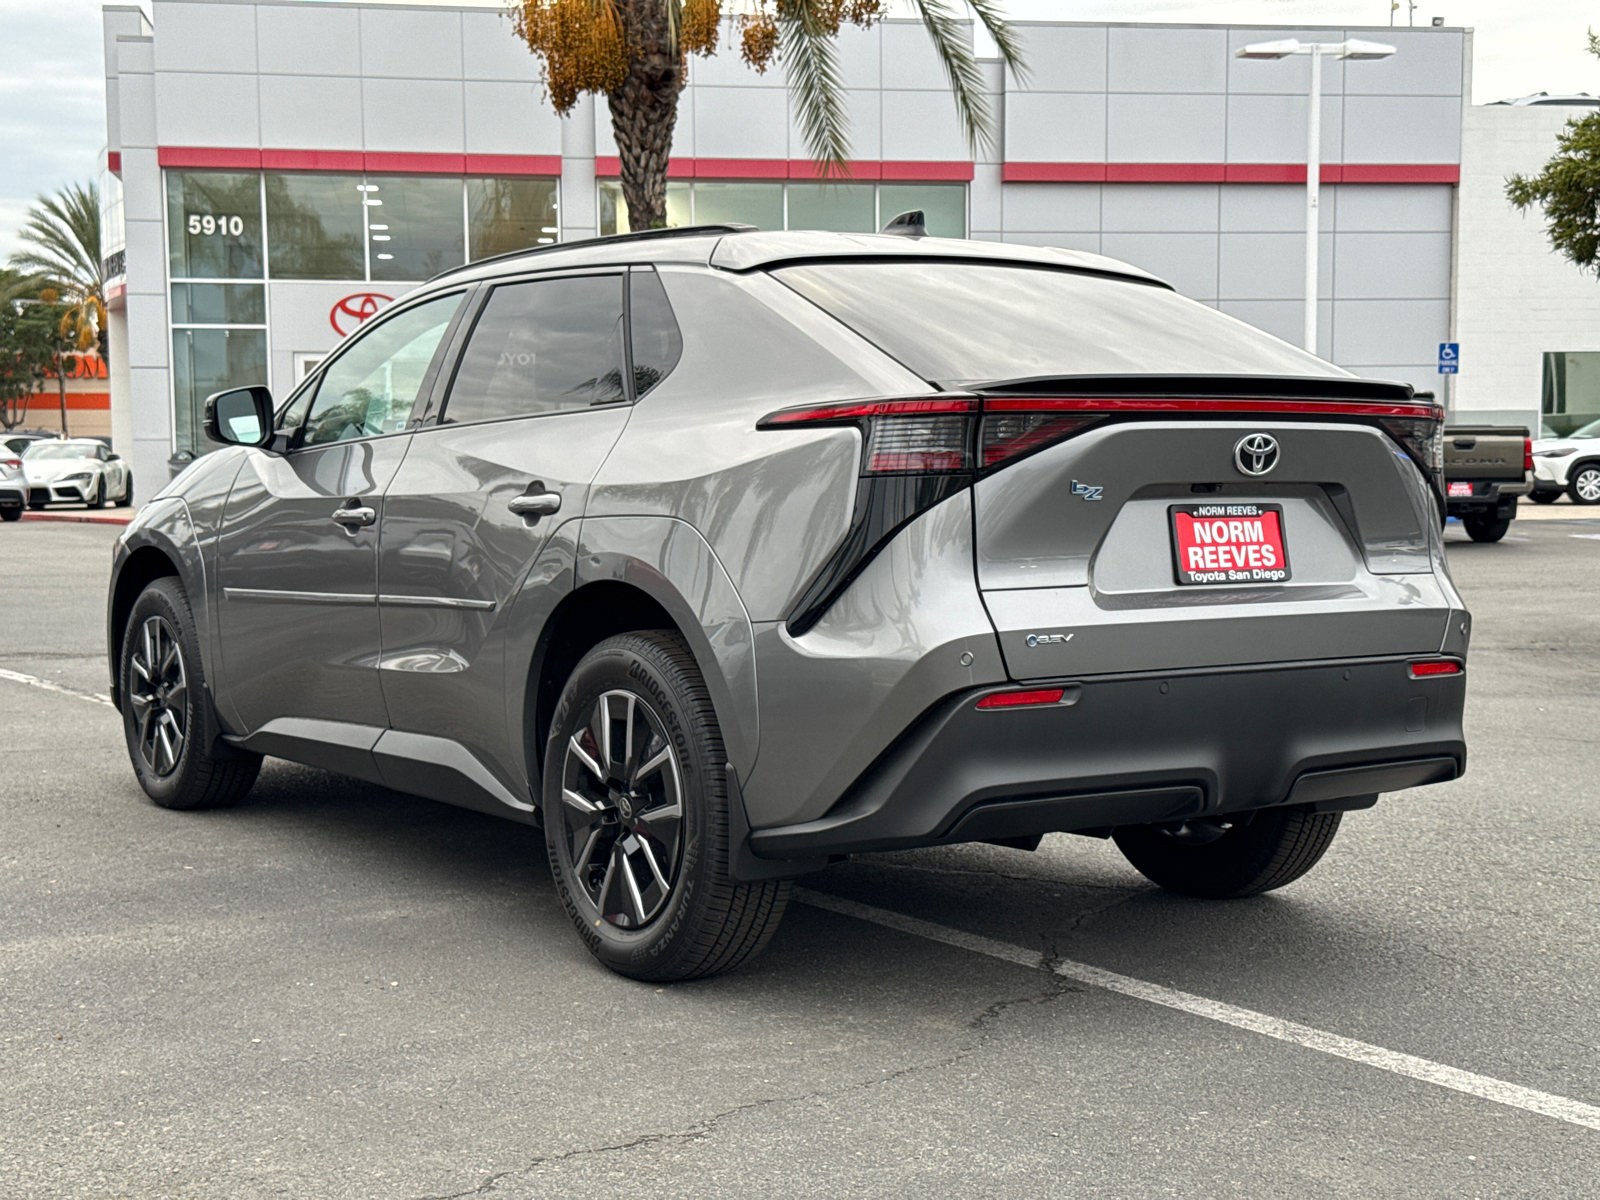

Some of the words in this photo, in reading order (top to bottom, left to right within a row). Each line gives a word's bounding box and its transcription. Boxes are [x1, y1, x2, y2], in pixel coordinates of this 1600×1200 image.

[188, 214, 244, 236] 5910
[1199, 506, 1225, 516] NORM
[1227, 506, 1257, 516] REEVES
[1193, 521, 1264, 544] NORM
[1187, 544, 1276, 569] REEVES
[1188, 570, 1226, 583] Toyota
[1228, 570, 1250, 580] San
[1252, 569, 1285, 580] Diego
[627, 658, 694, 775] BRIDGESTONE
[547, 839, 603, 953] BRIDGESTONE
[651, 879, 695, 957] TURANZA
